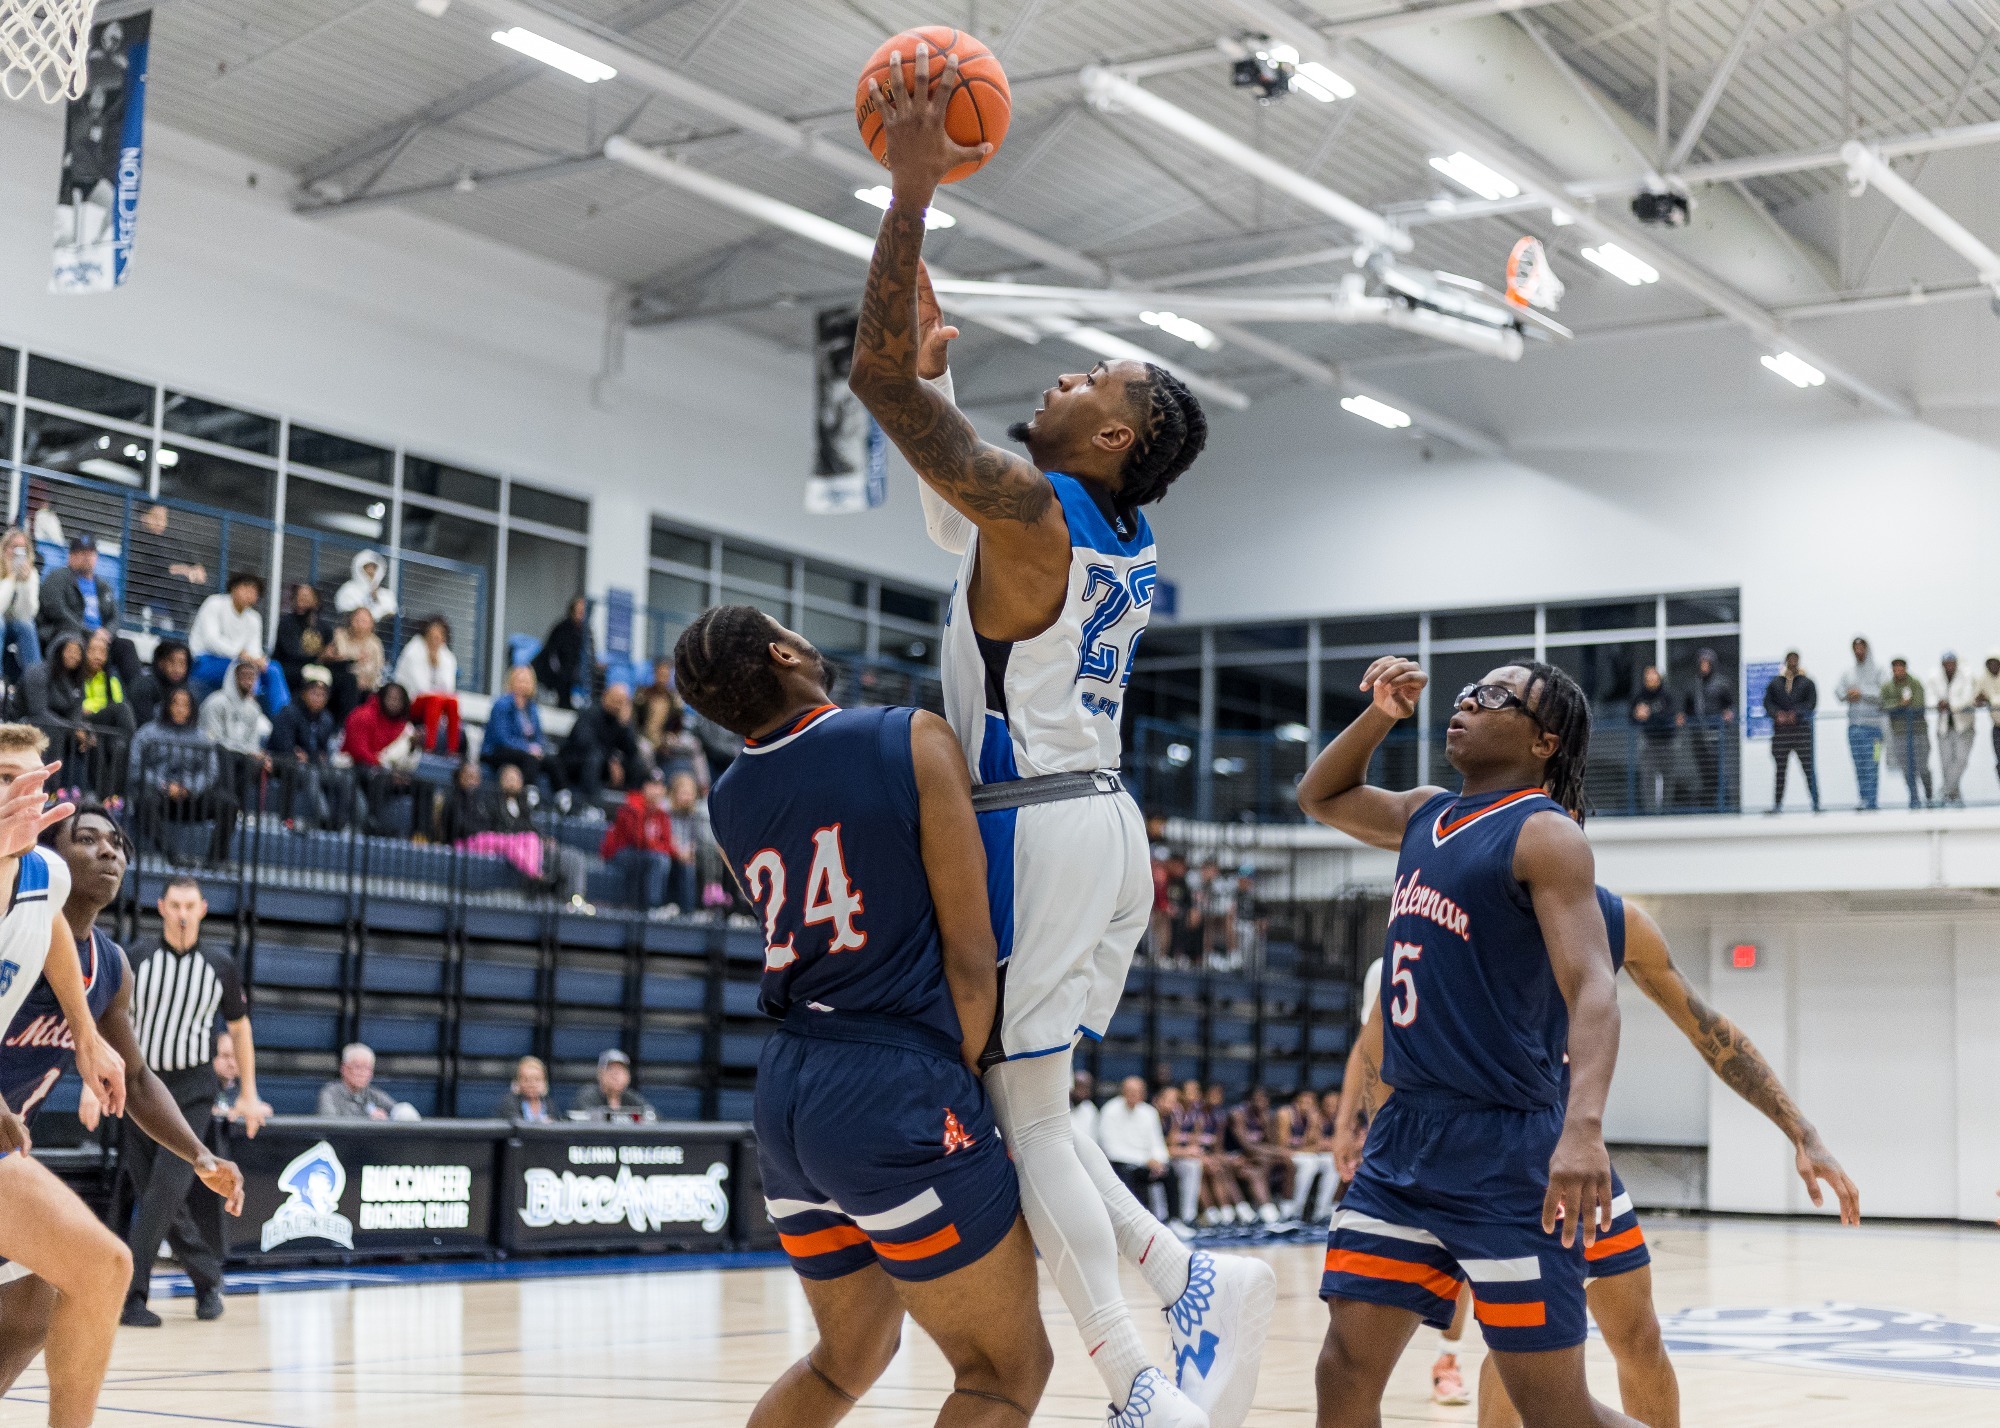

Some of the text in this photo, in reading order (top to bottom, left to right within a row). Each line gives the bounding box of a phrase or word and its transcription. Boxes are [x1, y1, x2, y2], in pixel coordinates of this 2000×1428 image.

[744, 822, 867, 972] 24
[1390, 941, 1422, 1028] 5
[619, 1146, 684, 1164] COLLEGE
[361, 1165, 471, 1201] BUCCANEER
[518, 1162, 729, 1232] BUCCANEERS
[359, 1202, 469, 1229] BACKER CLUB
